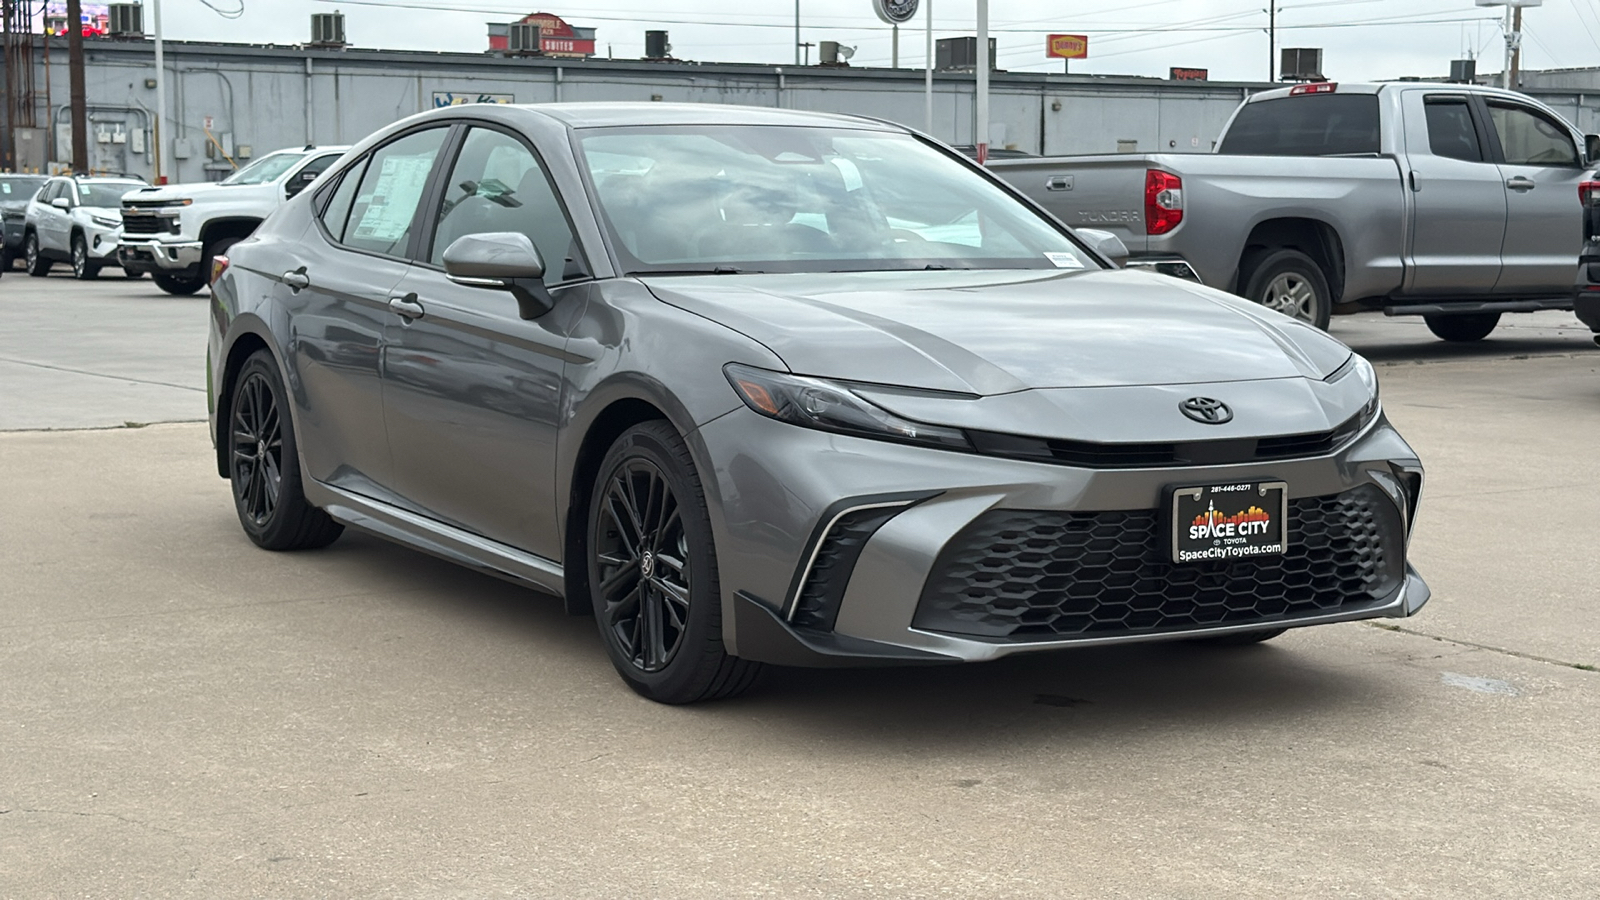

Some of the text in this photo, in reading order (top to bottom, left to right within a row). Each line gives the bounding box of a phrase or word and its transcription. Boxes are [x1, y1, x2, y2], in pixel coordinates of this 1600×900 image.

[545, 41, 573, 51] SUITES
[1078, 210, 1141, 222] TUNDRA
[1211, 484, 1251, 493] 281-446-0271
[1189, 516, 1270, 539] SPACE CITY
[1223, 537, 1247, 545] TOYOTA
[1179, 544, 1281, 561] SpaceCityToyota.com
